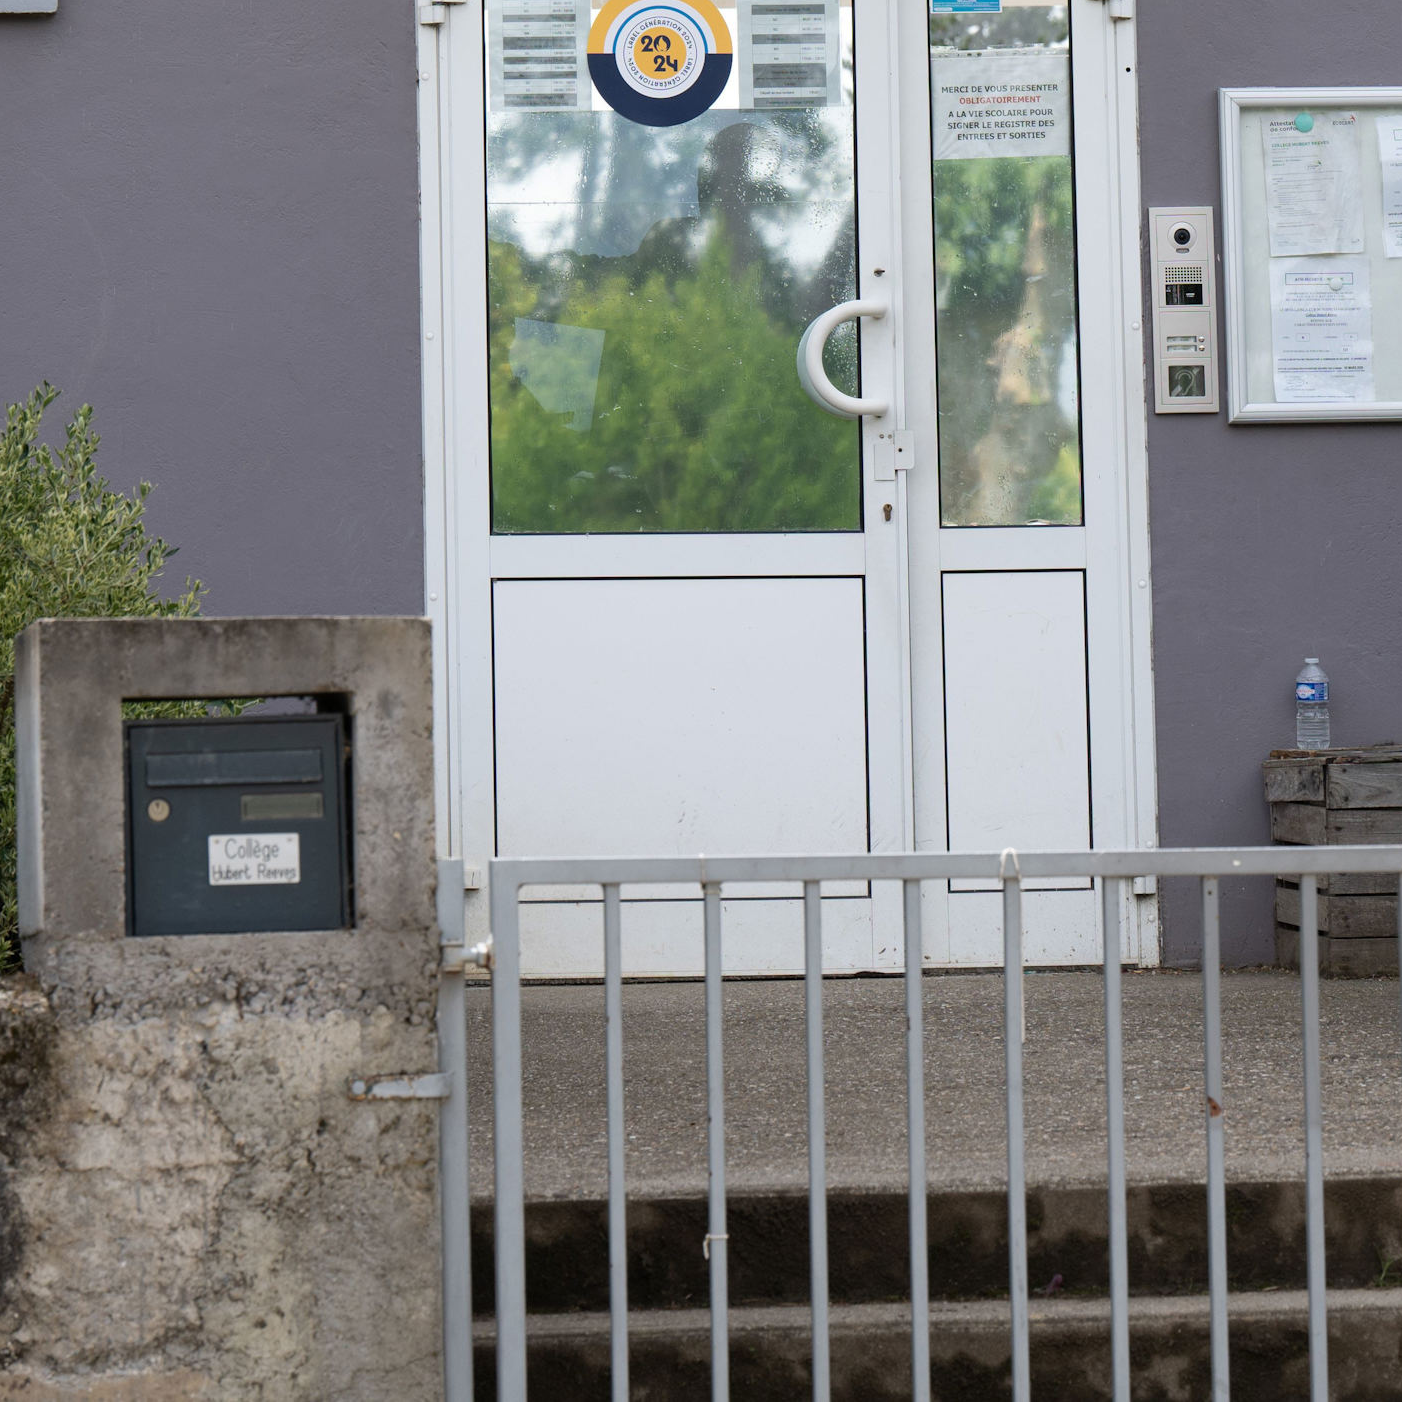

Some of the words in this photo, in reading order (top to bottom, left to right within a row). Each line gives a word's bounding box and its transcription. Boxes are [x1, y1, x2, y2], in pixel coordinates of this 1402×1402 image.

[628, 30, 640, 49] LABEL
[639, 18, 682, 32] GÉNÉRATION
[681, 31, 694, 49] 2024
[640, 34, 672, 53] 20
[653, 54, 678, 73] 24
[941, 86, 969, 94] MERCI
[971, 85, 982, 93] DE
[984, 85, 1008, 93] VOUS
[1009, 84, 1058, 92] PRESENTER
[959, 95, 1041, 105] OBLIGATOIREMENT
[968, 110, 984, 118] VIE
[985, 109, 1028, 118] SCOLAIRE
[1029, 108, 1054, 116] POUR
[947, 122, 980, 130] SIGNER
[994, 120, 1037, 129] REGISTRE
[1038, 120, 1055, 128] DES
[957, 133, 995, 141] ENTREES
[1009, 131, 1046, 140] SORTIES
[224, 837, 280, 862] Collège
[257, 862, 297, 879] Reeves
